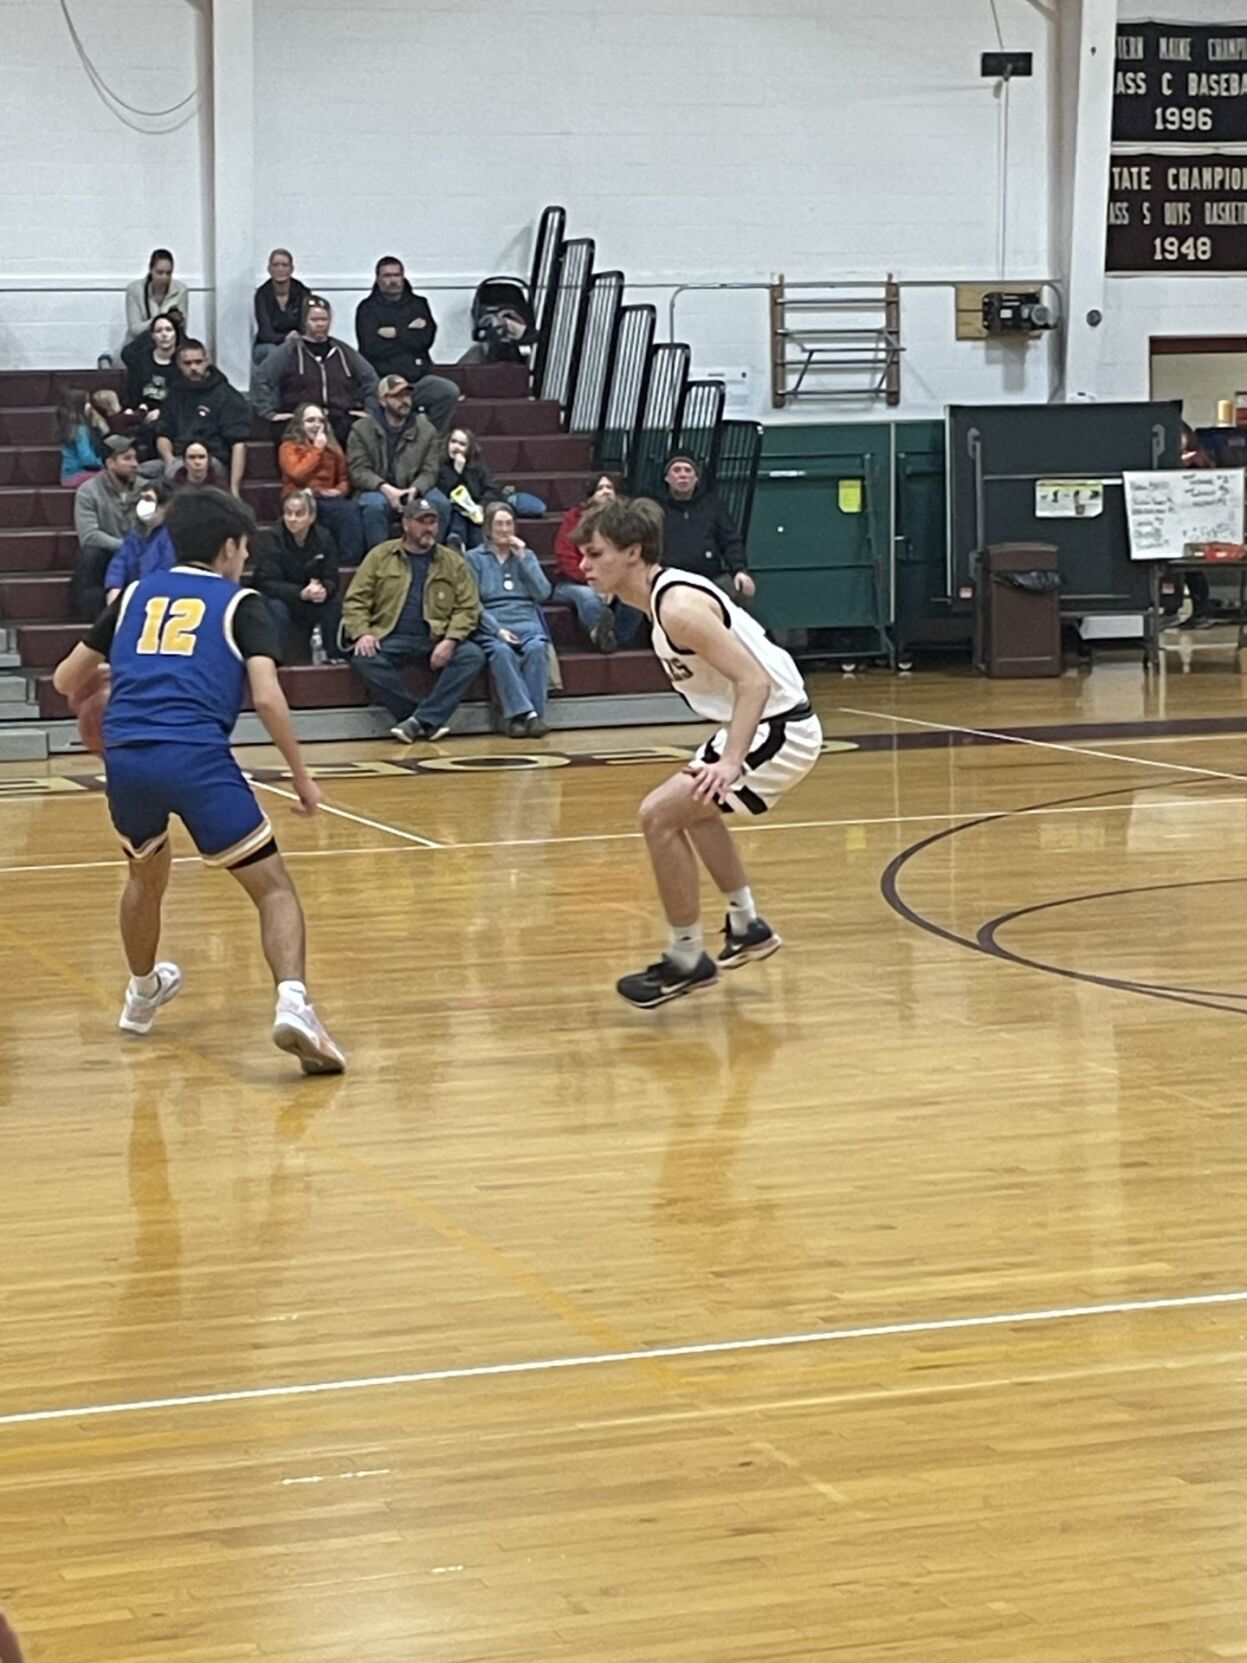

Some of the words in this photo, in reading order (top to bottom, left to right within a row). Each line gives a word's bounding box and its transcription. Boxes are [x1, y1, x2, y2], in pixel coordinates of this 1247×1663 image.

[1161, 72, 1173, 96] C
[1154, 107, 1213, 130] 1996
[1112, 167, 1151, 190] TATE
[1143, 202, 1151, 225] S
[1153, 236, 1212, 260] 1948
[136, 596, 206, 656] 12
